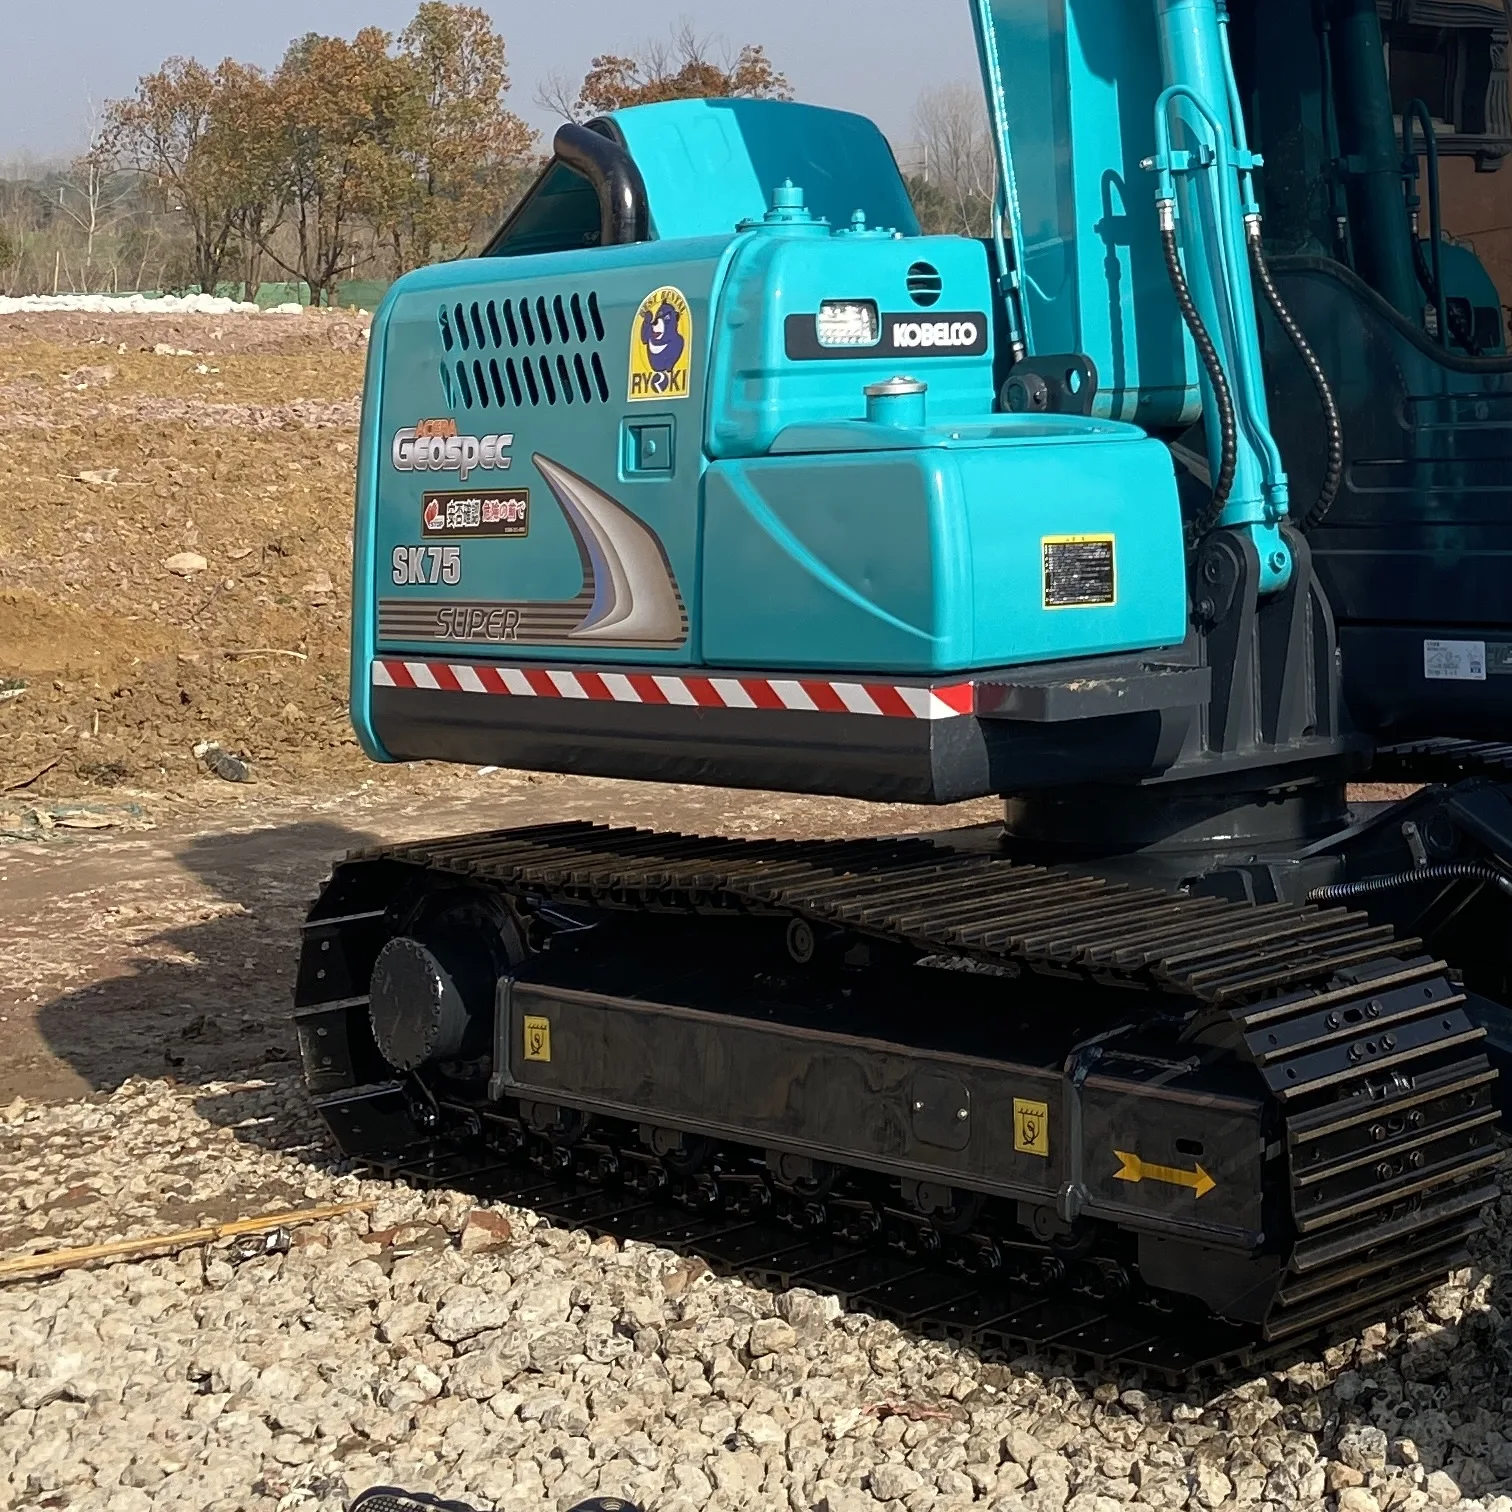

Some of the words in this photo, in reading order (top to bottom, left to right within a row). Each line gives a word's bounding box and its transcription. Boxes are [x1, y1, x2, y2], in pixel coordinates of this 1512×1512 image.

[893, 322, 977, 347] KOBELCO
[392, 546, 461, 585] SK75
[435, 607, 521, 641] SUPER
